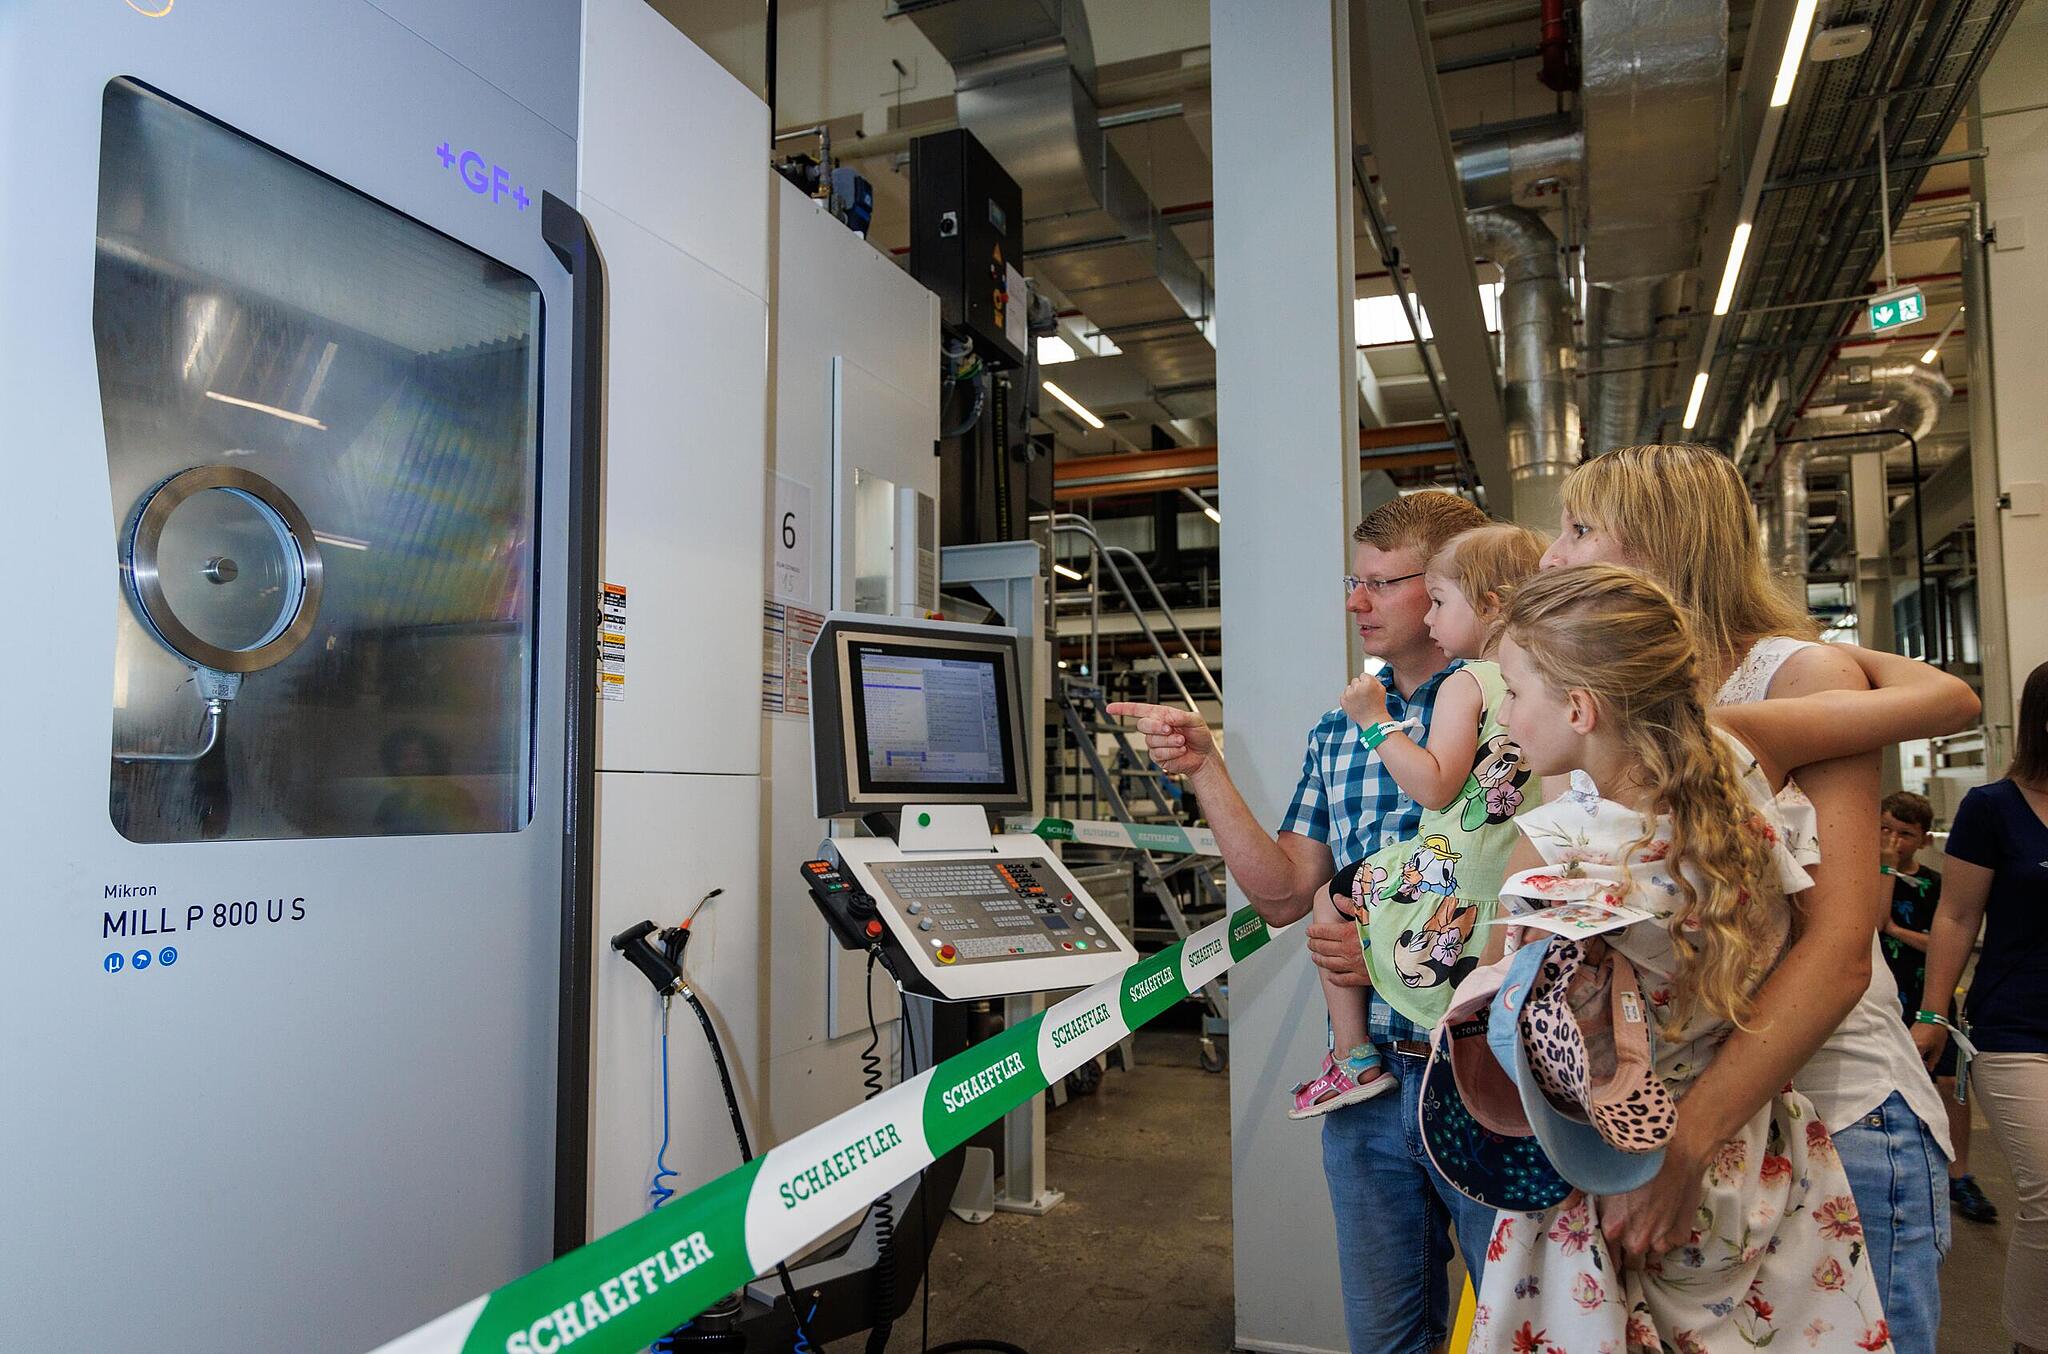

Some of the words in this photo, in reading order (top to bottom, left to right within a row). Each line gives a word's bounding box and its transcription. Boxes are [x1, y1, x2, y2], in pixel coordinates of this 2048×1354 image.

[782, 512, 796, 549] 6
[104, 884, 157, 899] Mikron
[103, 907, 176, 938] MILL
[186, 904, 204, 931] P
[212, 900, 258, 928] 800
[1188, 938, 1223, 968] SCHAEFFLER
[1130, 966, 1175, 1002] SCHAEFFLER
[1051, 1003, 1111, 1048] SCHAEFFLER
[942, 1051, 1026, 1113] SCHAEFFLER
[1310, 1079, 1328, 1096] FILA
[779, 1123, 902, 1210] SCHAEFFLER
